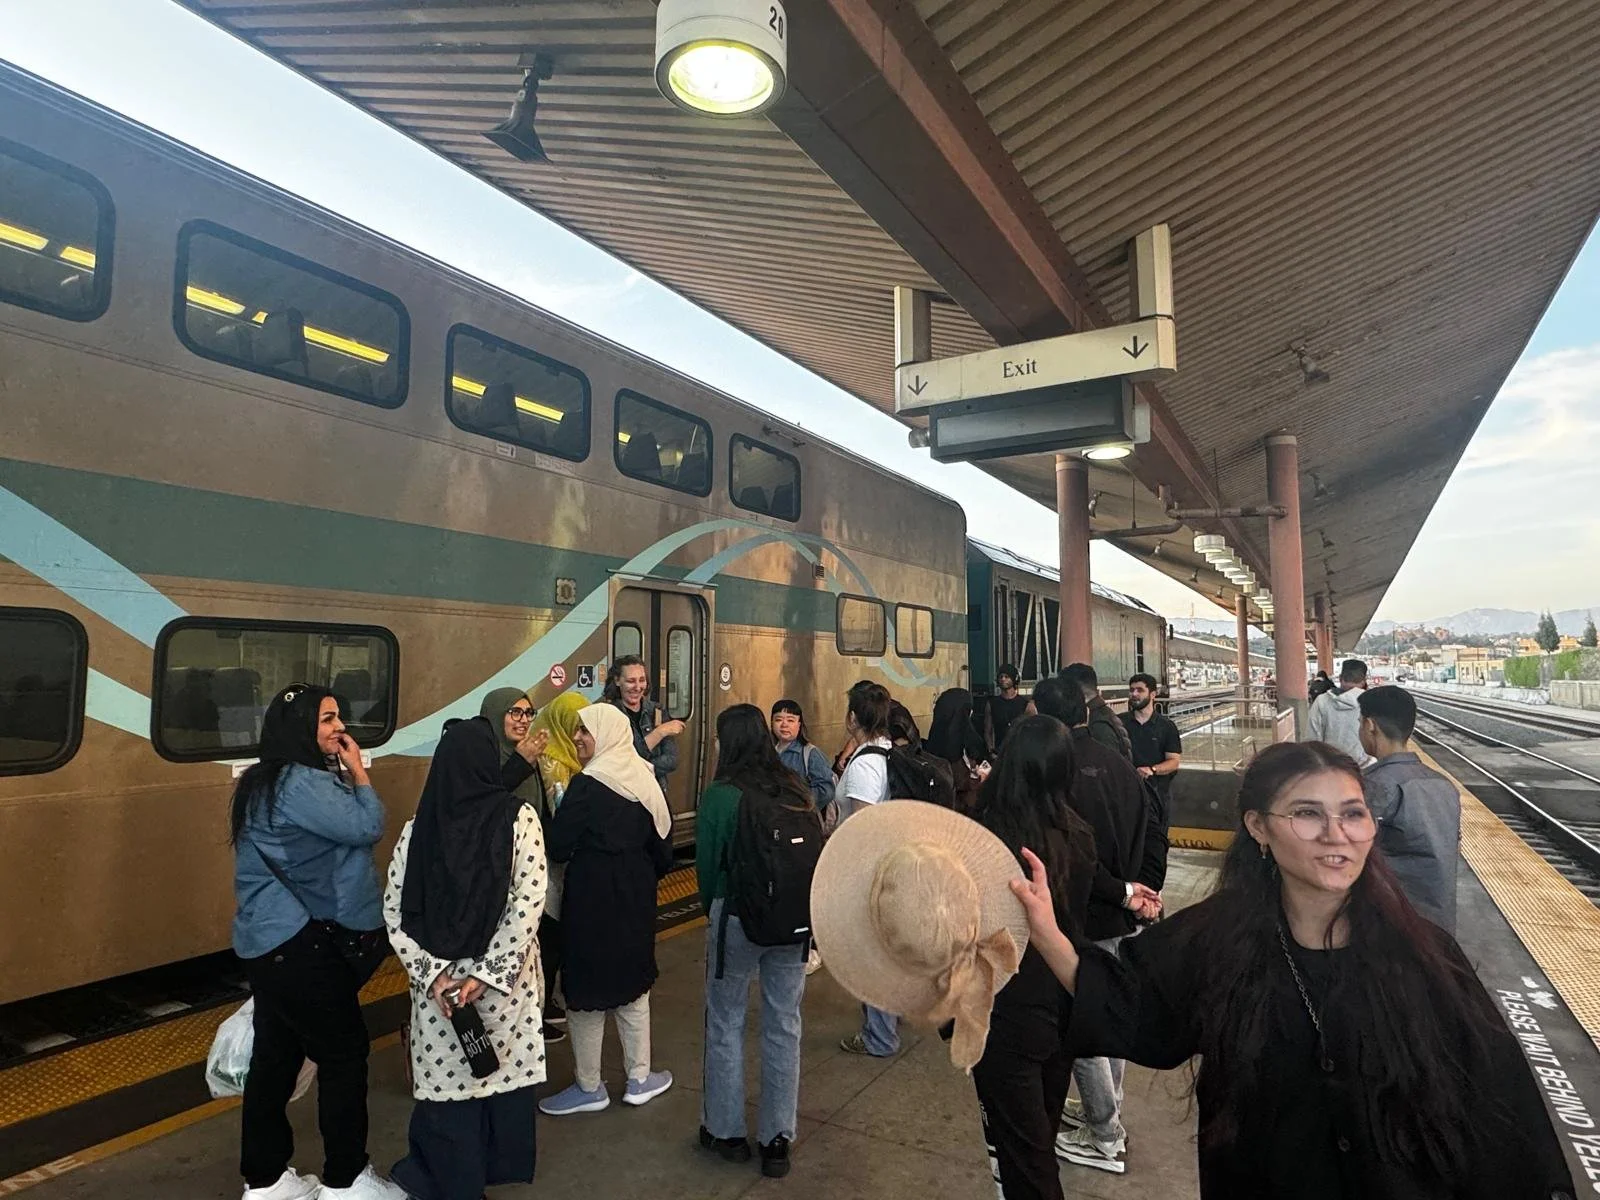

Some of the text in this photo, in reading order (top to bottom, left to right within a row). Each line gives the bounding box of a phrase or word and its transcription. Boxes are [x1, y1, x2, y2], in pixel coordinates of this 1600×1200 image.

[769, 6, 783, 40] 20
[1003, 358, 1038, 378] Exit
[461, 1028, 475, 1044] MY
[1497, 989, 1600, 1194] PLEASE WAIT BEHIND YELL
